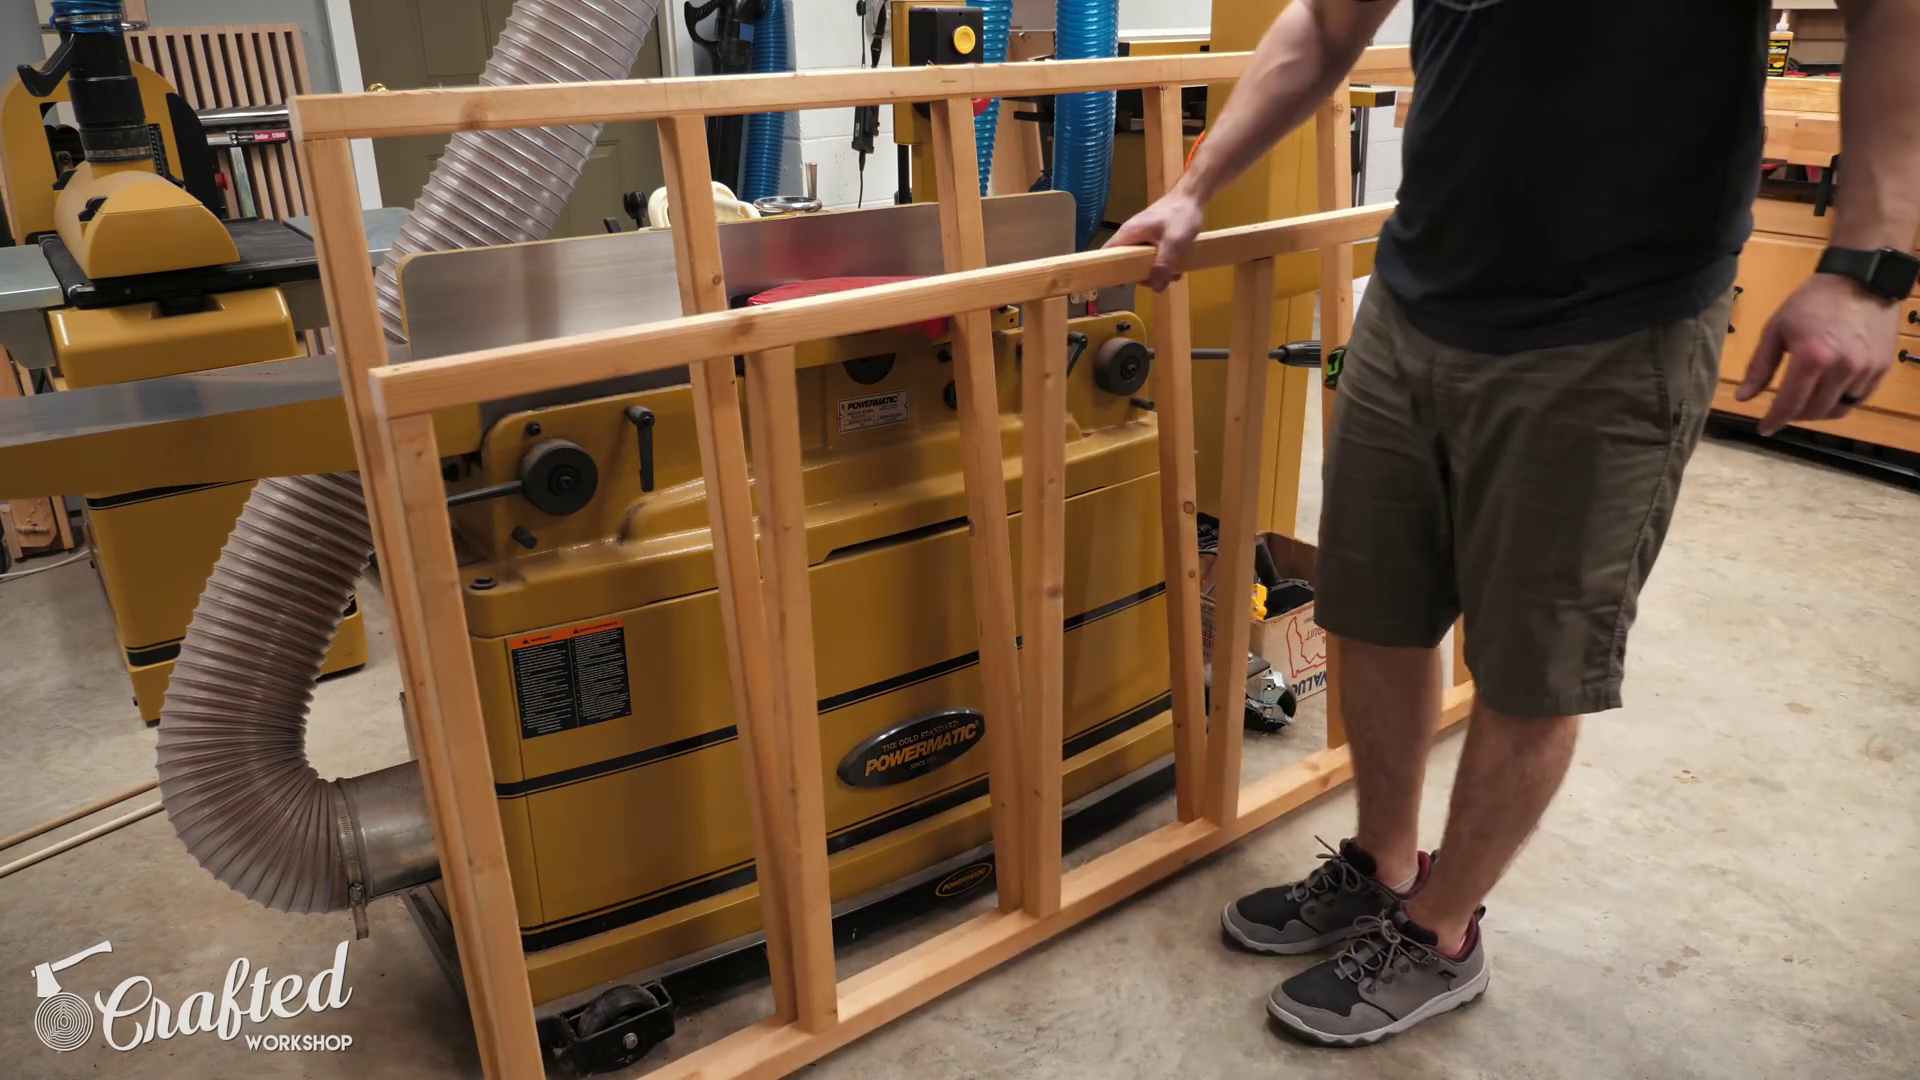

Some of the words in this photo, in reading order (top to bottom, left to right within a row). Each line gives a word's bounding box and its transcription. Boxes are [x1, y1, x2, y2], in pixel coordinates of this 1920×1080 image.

[847, 395, 898, 410] POWERMATIC
[864, 722, 978, 777] POWERMATIC
[882, 741, 898, 752] THE
[898, 734, 919, 746] GOLD
[920, 720, 959, 739] STANDARD
